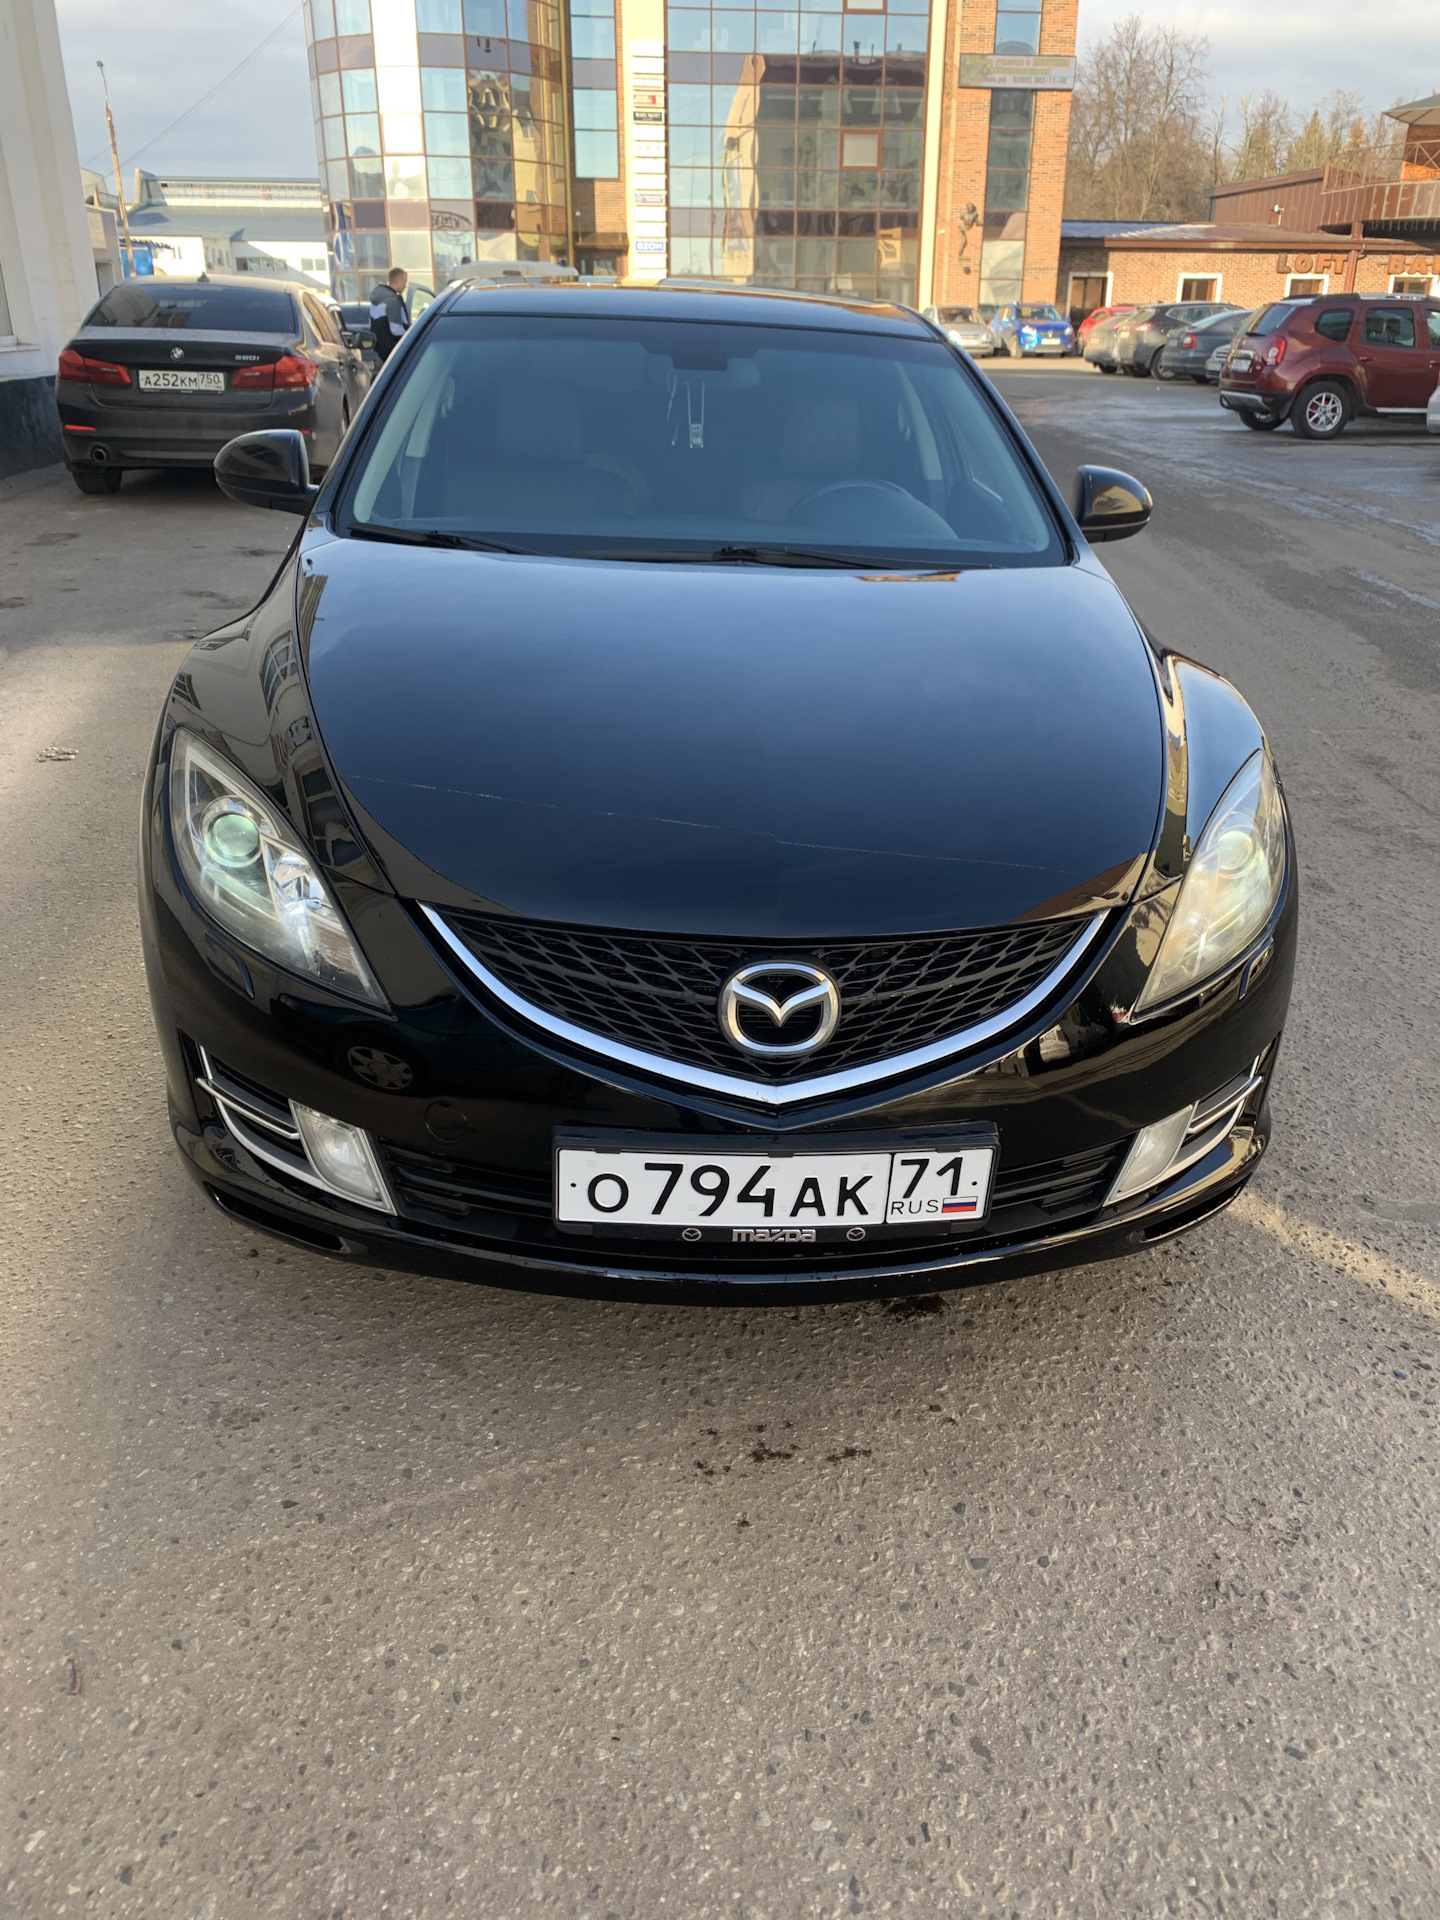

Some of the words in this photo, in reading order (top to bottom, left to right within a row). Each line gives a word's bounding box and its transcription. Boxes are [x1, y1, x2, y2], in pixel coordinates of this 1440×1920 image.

[636, 242, 662, 250] OZON
[1276, 252, 1348, 274] LOFT
[199, 373, 220, 385] 750
[900, 1156, 963, 1199] 71
[890, 1199, 939, 1216] RUS
